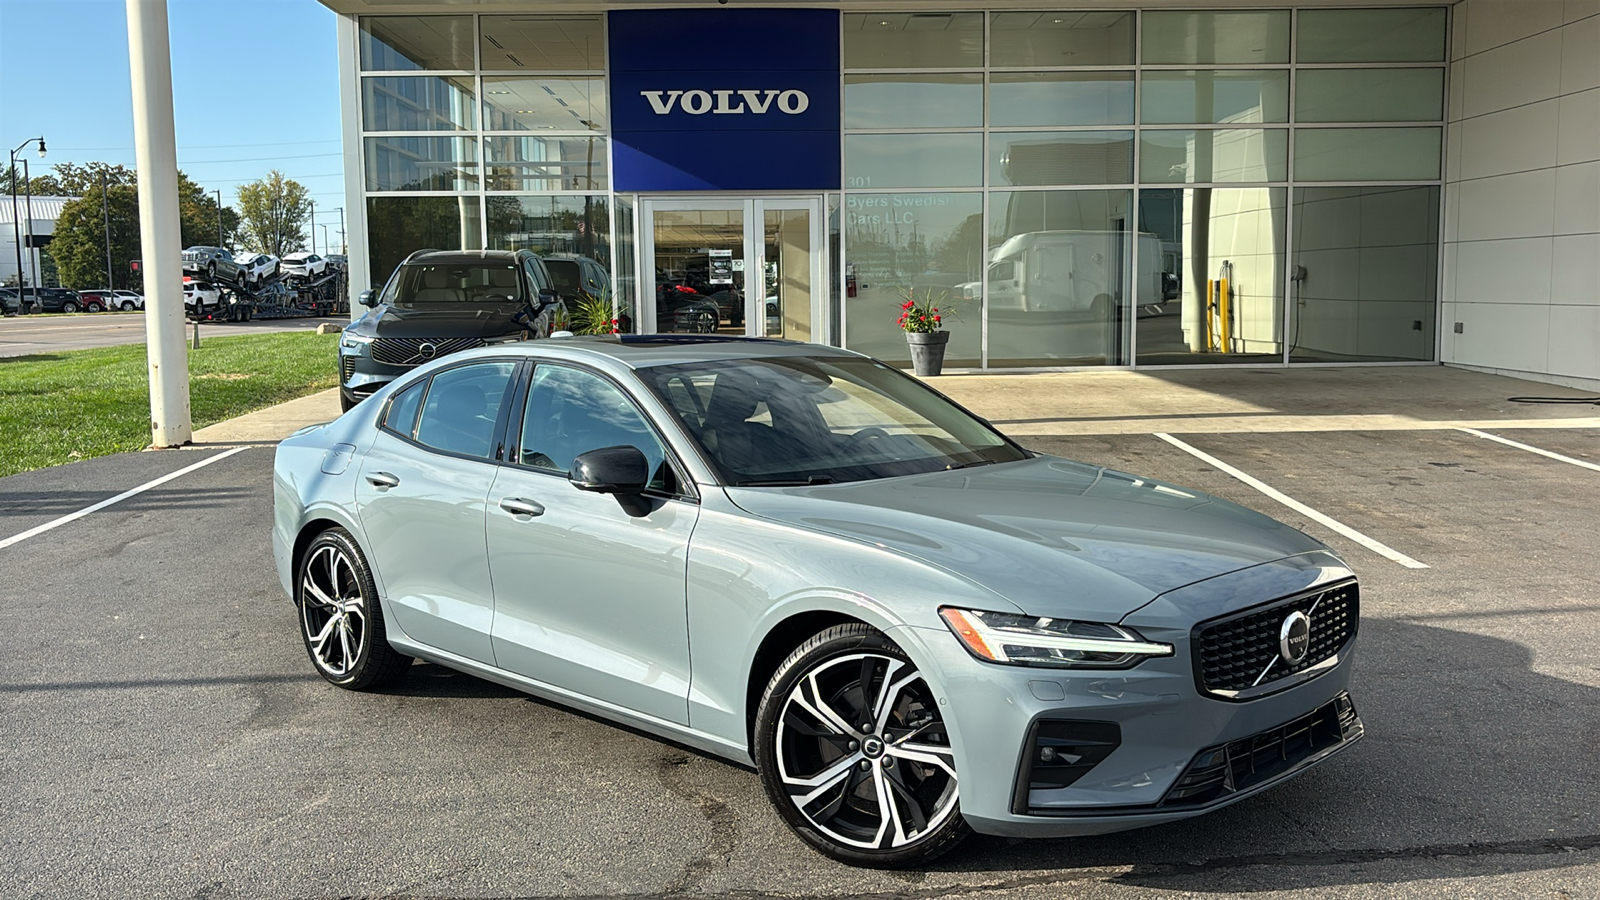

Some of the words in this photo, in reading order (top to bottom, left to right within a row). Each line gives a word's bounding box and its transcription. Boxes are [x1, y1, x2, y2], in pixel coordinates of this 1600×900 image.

[640, 89, 810, 115] VOLVO
[847, 176, 872, 187] 301
[847, 196, 888, 210] Byers
[847, 212, 881, 225] Cars
[885, 211, 914, 224] LLC
